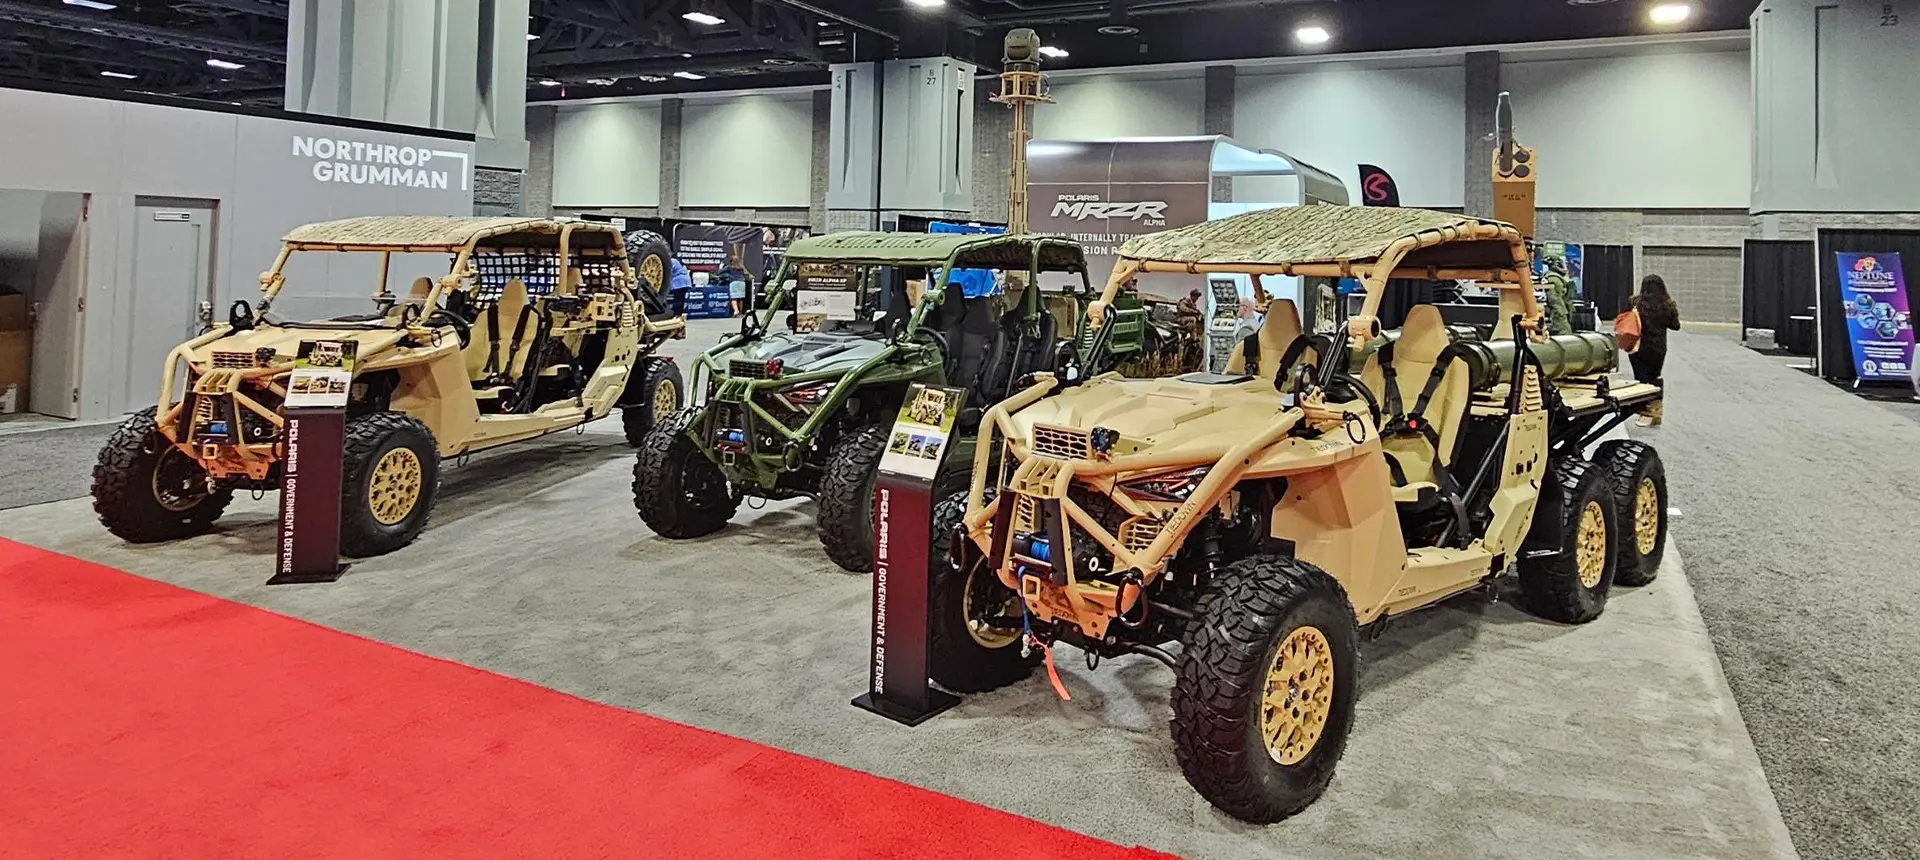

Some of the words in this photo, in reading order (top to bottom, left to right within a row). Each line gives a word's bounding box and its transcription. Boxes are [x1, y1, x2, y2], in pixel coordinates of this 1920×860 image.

[1880, 15, 1898, 26] 23
[926, 77, 937, 85] 27
[292, 135, 432, 167] NORTHROP
[313, 160, 448, 189] GRUMMAN
[1050, 201, 1169, 222] MRZR
[1058, 194, 1100, 202] POLARIS
[1070, 232, 1117, 243] INTERNALLY
[1143, 219, 1166, 227] ALPHA
[1846, 270, 1895, 280] NEPTUNE
[287, 419, 299, 473] POLARIS
[284, 478, 297, 531] GOVERNMENT
[1166, 501, 1197, 538] TIEDOWN
[878, 488, 889, 560] POLARIS
[282, 537, 293, 574] DEFENSE
[876, 567, 887, 636] GOVERNMENT
[874, 643, 884, 695] DEFENSE
